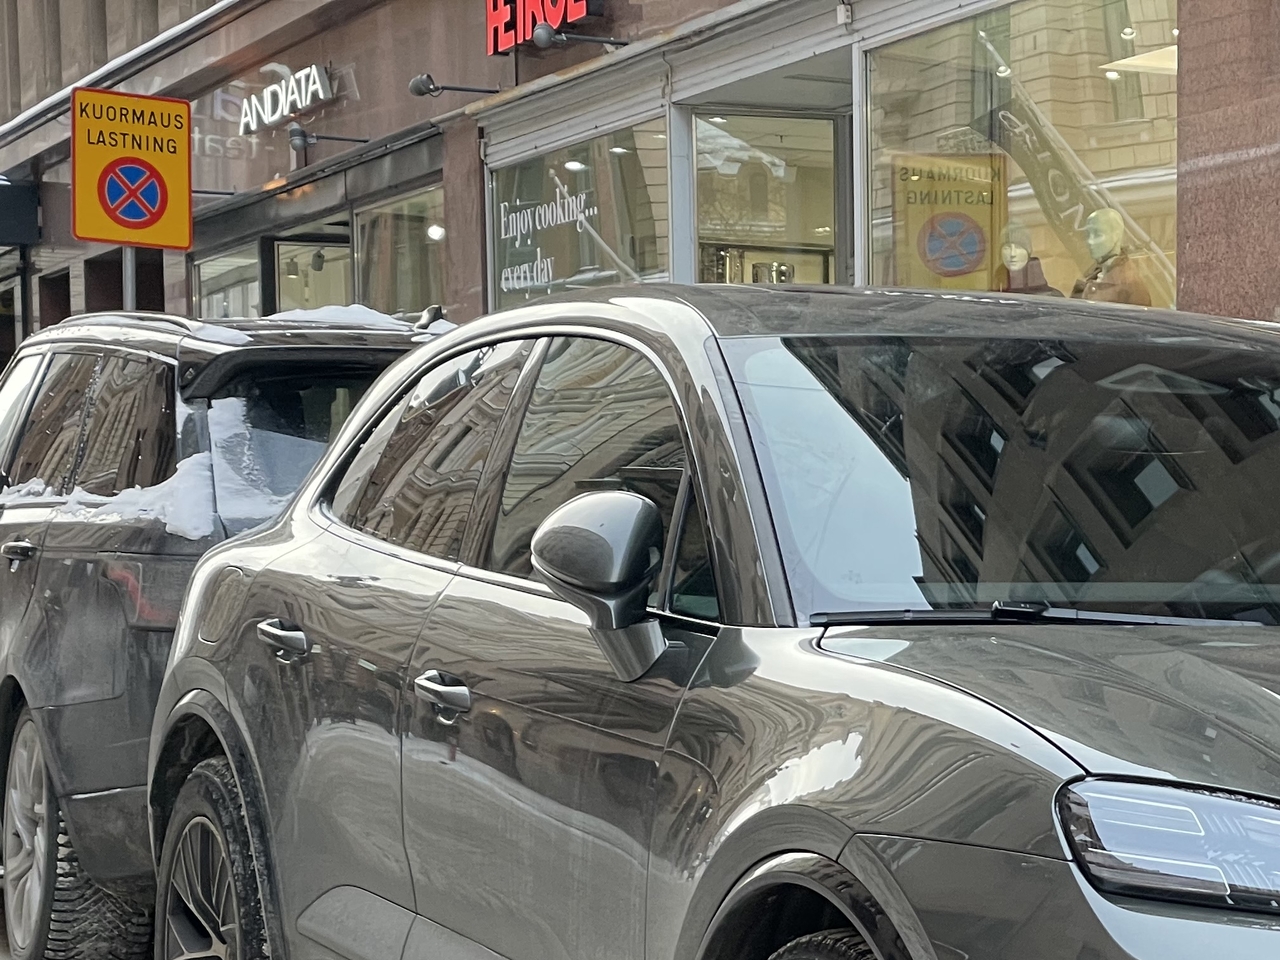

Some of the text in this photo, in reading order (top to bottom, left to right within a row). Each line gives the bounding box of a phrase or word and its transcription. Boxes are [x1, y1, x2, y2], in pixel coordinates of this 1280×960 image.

[79, 101, 184, 130] KUORMAUS
[238, 64, 324, 136] ANDIATA
[87, 128, 177, 154] LASTNING
[500, 198, 535, 248] Enjoy
[533, 247, 555, 295] day
